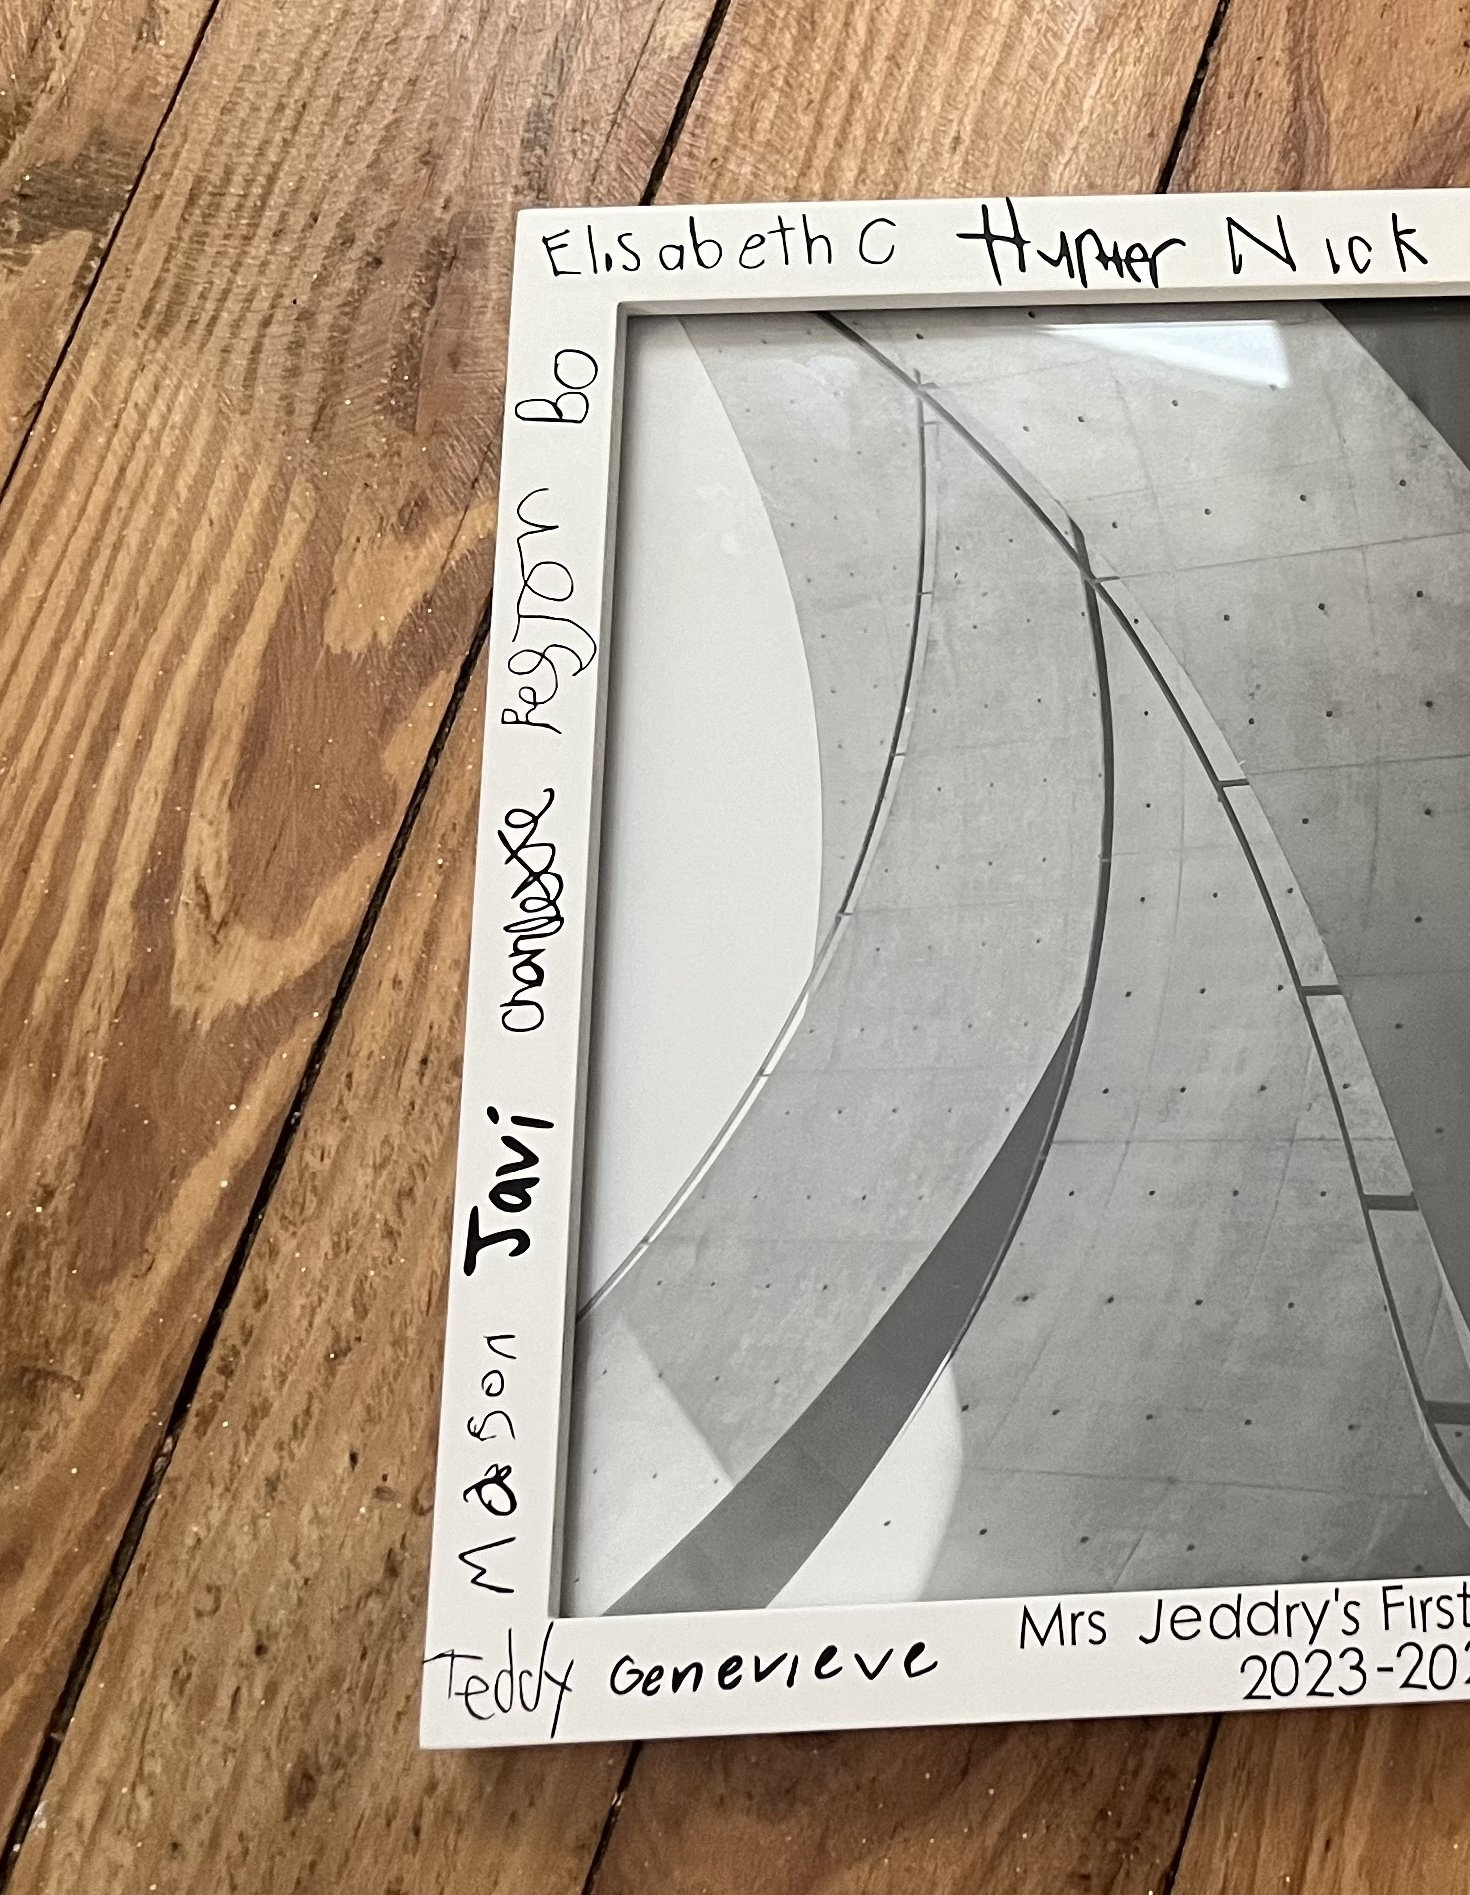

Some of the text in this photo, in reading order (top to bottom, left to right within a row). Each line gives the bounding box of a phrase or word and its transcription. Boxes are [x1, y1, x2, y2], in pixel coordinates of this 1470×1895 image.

[540, 212, 898, 278] Elisabeth C
[1224, 211, 1430, 276] Nick
[462, 1104, 556, 1278] Javi
[1018, 1601, 1108, 1651] Mrs
[1137, 1586, 1362, 1647] Jeddry's
[423, 1620, 576, 1739] Teddy
[608, 1640, 939, 1698] Genevieve
